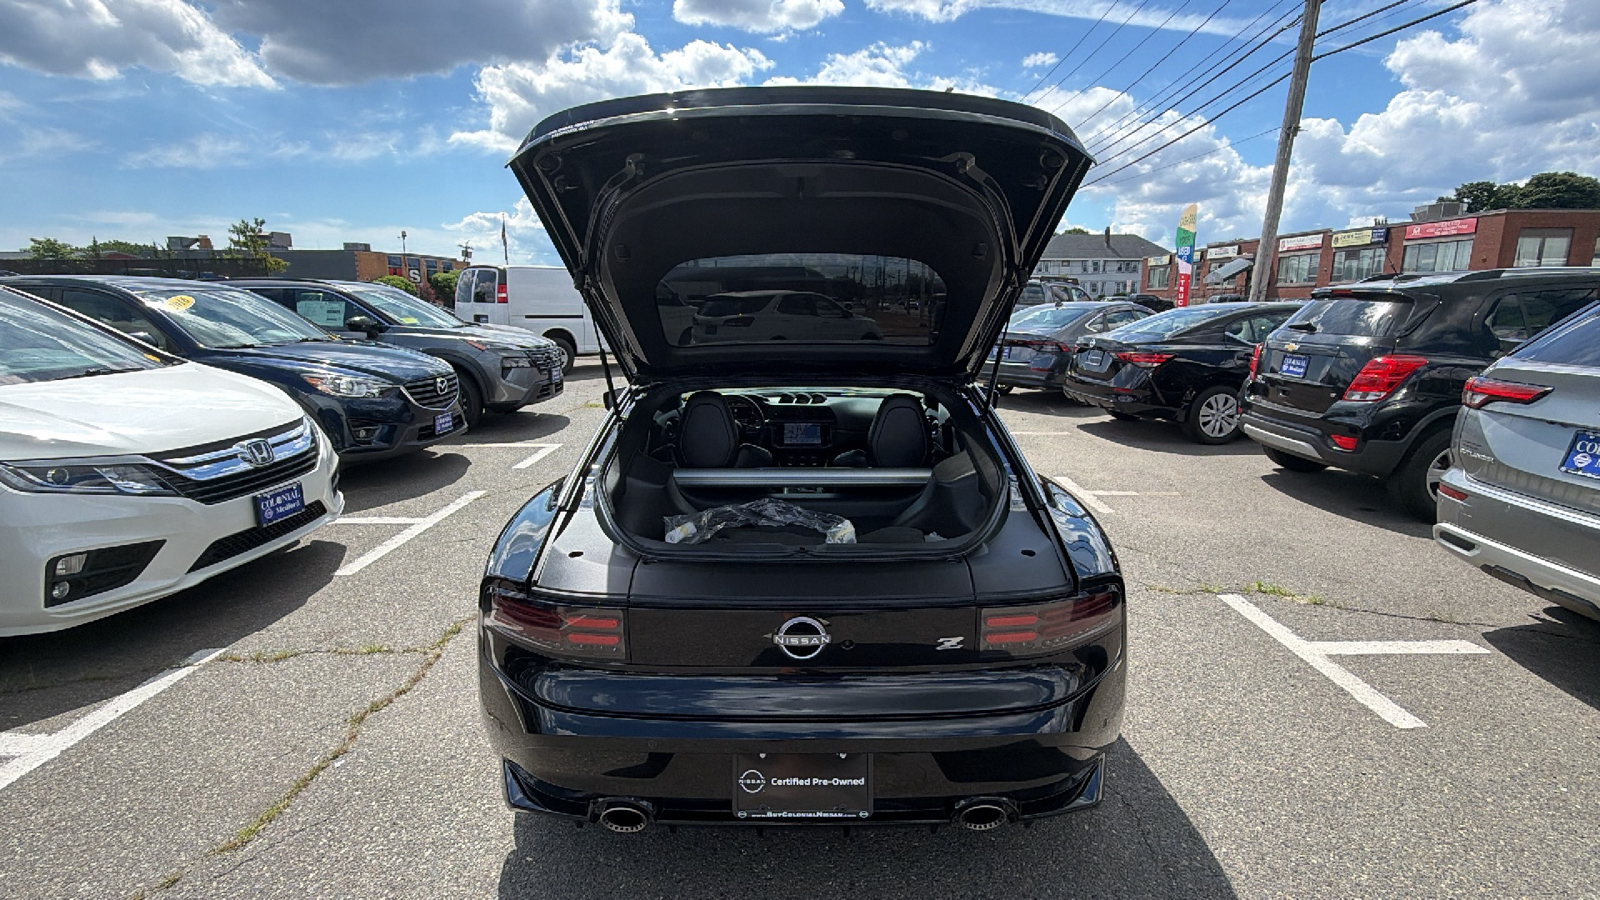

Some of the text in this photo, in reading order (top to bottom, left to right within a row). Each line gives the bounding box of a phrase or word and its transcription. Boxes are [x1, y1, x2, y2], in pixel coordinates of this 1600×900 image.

[1178, 246, 1190, 256] USED
[261, 490, 301, 510] COLONIAL
[276, 499, 300, 513] Medford
[775, 636, 831, 644] NISSAN
[936, 636, 964, 650] Z
[771, 777, 865, 786] Certified Pre-Owned
